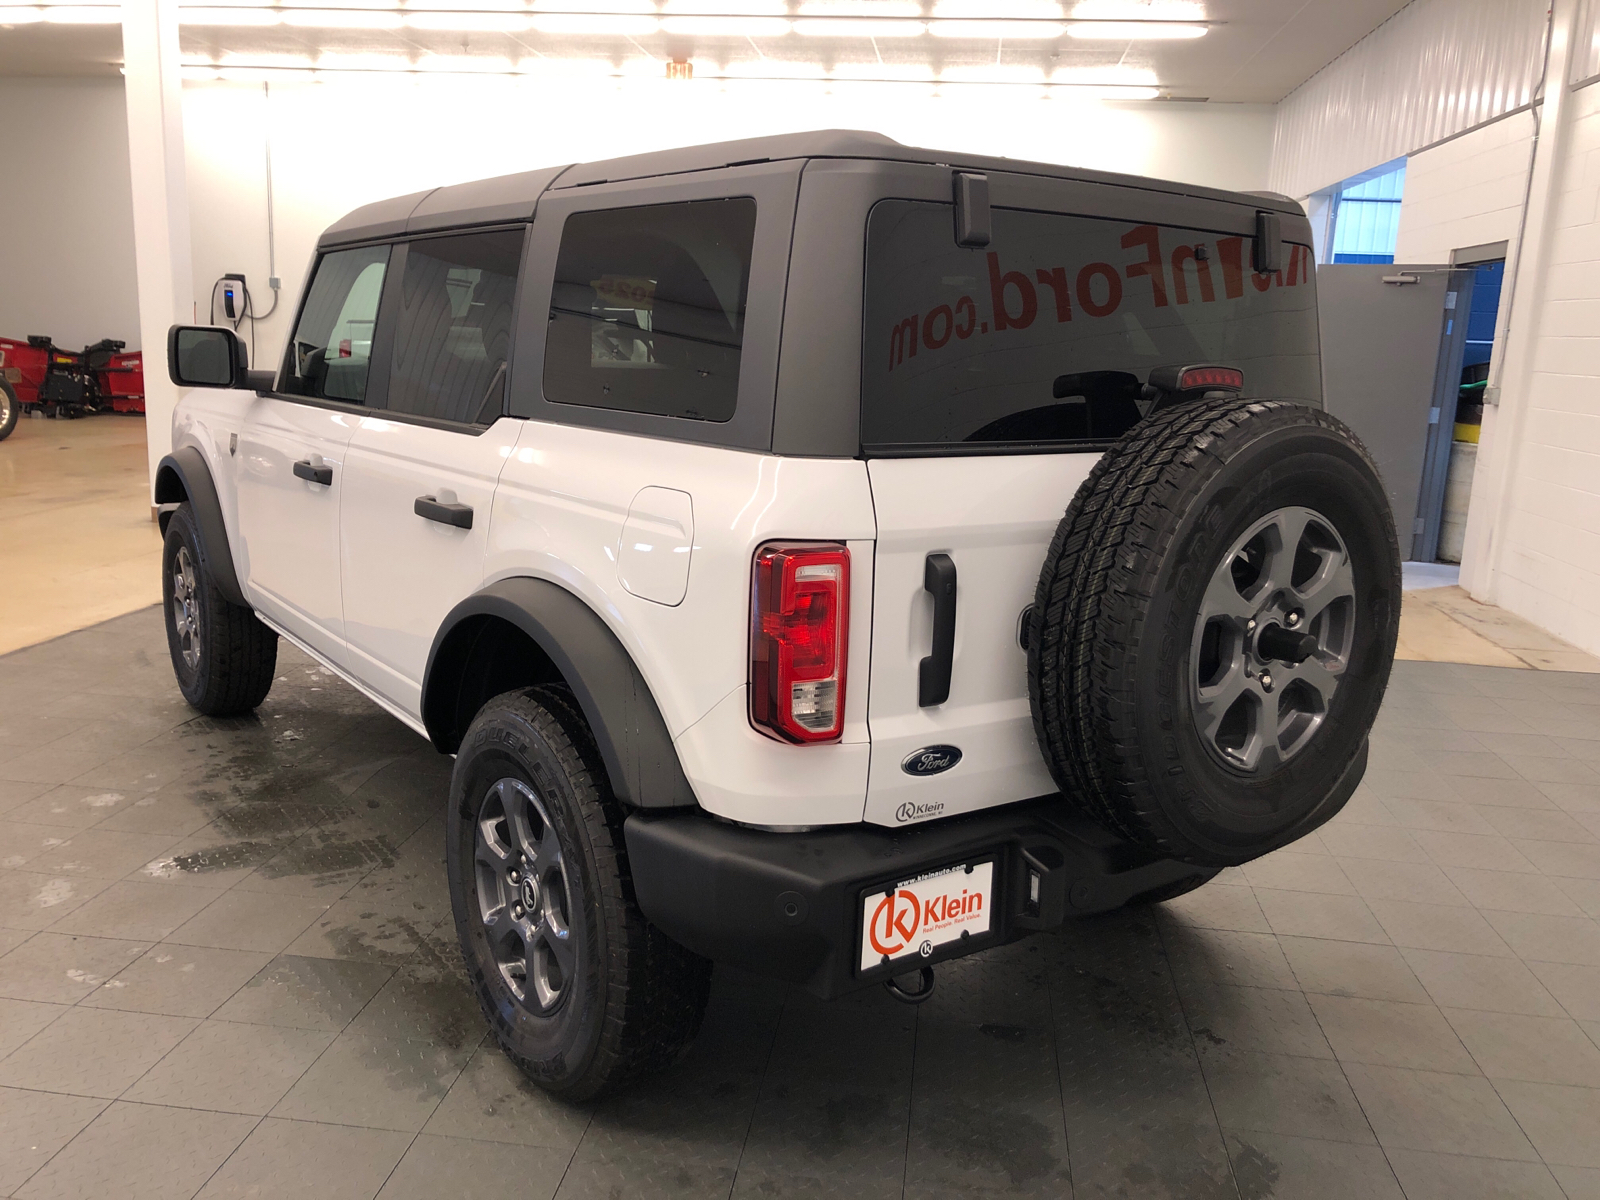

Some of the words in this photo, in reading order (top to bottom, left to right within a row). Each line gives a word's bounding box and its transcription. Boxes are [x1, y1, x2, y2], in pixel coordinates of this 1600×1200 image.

[917, 753, 950, 771] Ford
[916, 801, 944, 815] Klein
[897, 863, 967, 888] www.kleinauto.com
[923, 888, 983, 926] Klein
[922, 926, 934, 934] Real
[953, 916, 965, 924] Real
